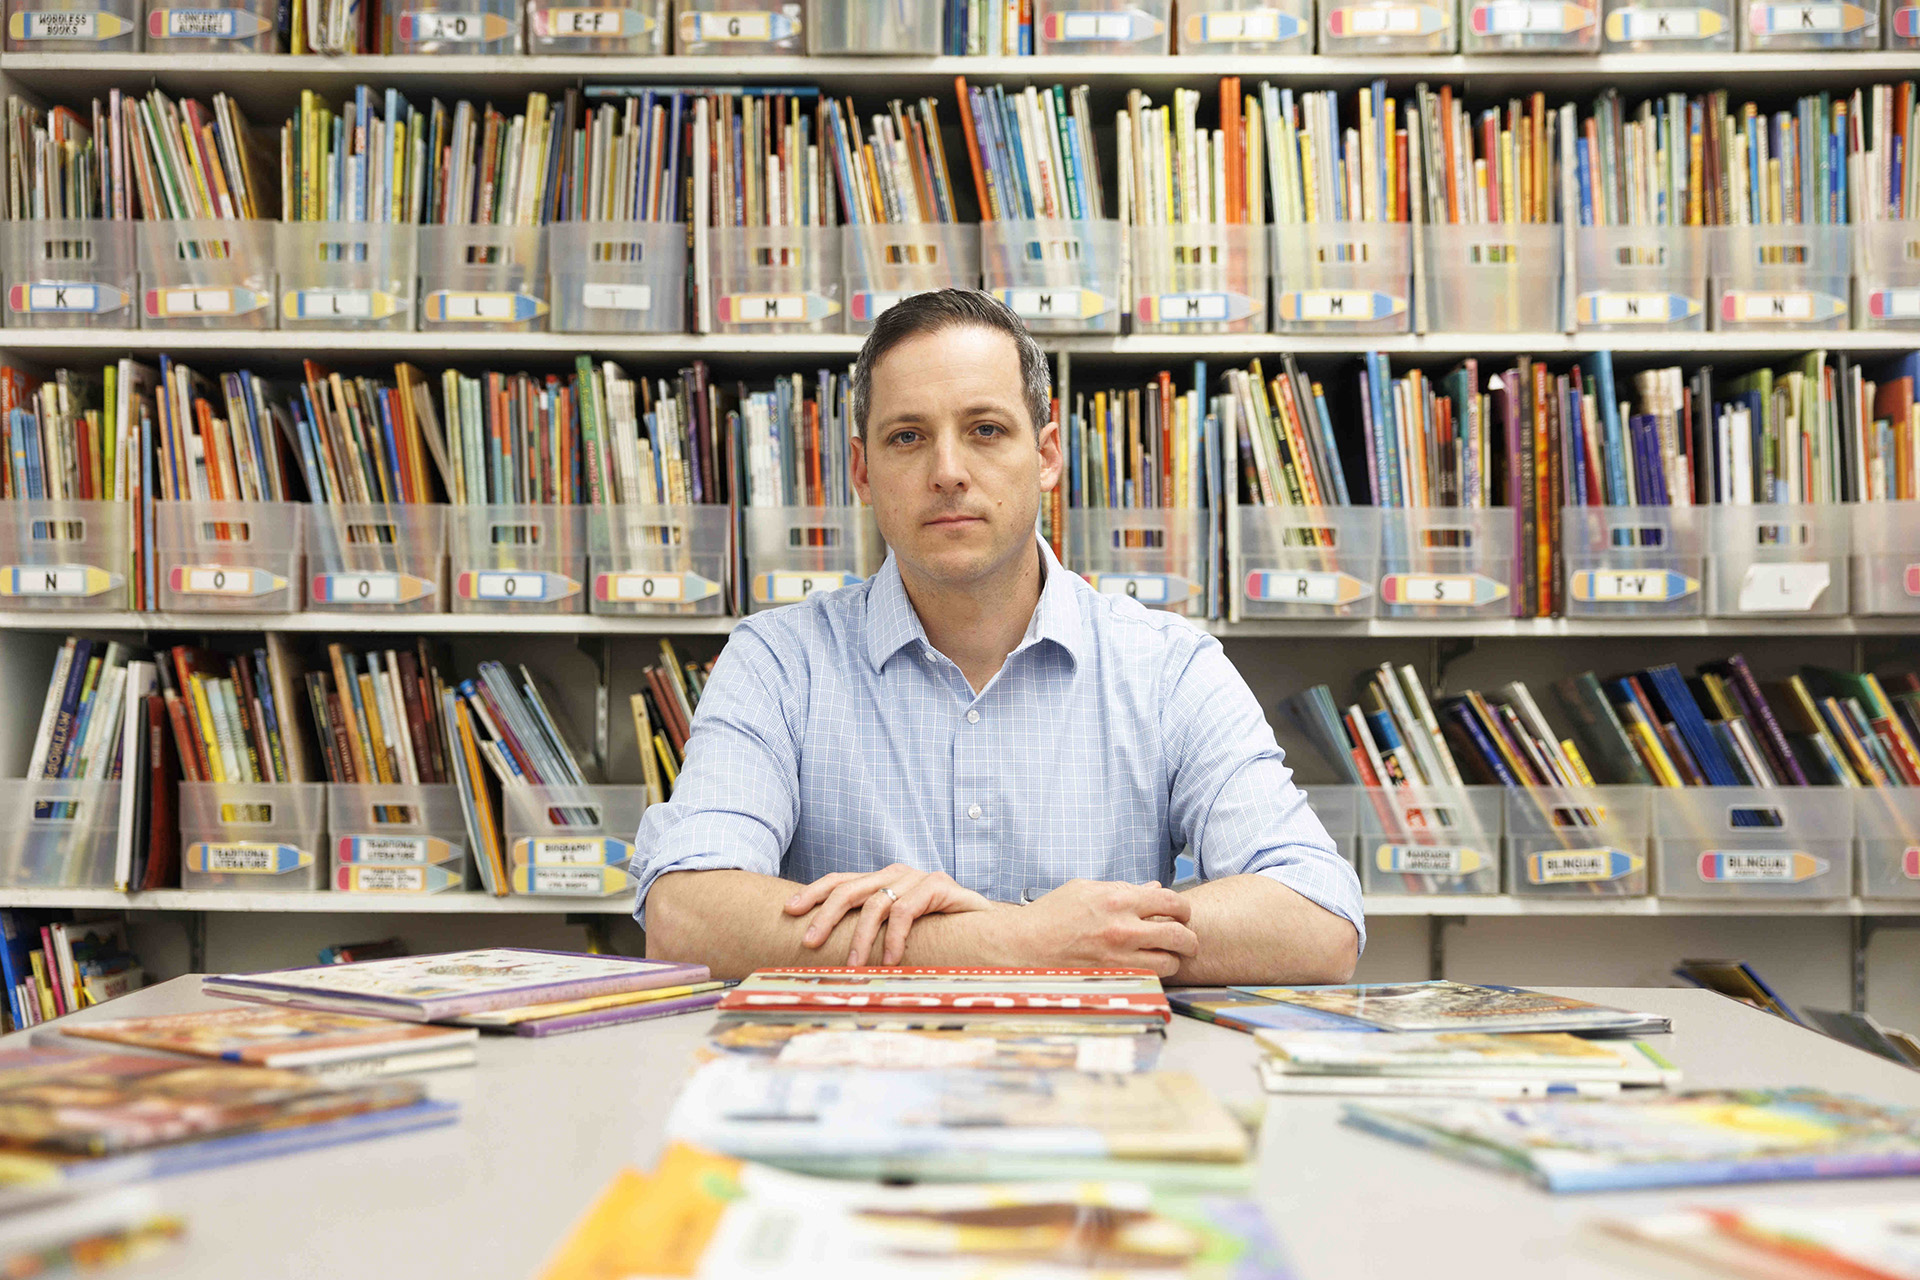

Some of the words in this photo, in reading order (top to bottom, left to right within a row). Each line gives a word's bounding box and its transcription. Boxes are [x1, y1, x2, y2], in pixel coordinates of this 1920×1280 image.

[39, 13, 87, 26] WORDLESS
[433, 17, 467, 37] A-D
[573, 12, 604, 32] E-F
[728, 17, 741, 37] G
[1657, 14, 1670, 31] K
[1801, 9, 1814, 27] K
[46, 25, 78, 36] BOOKS
[55, 289, 68, 308] K
[193, 292, 203, 311] L
[332, 295, 341, 314] L
[605, 290, 621, 306] T
[1039, 294, 1052, 312] M
[1330, 298, 1343, 314] M
[1772, 299, 1784, 315] N
[474, 298, 484, 317] L
[765, 300, 778, 317] M
[1187, 299, 1199, 316] M
[1626, 300, 1638, 315] N
[45, 573, 57, 591] N
[213, 571, 226, 589] O
[358, 580, 371, 598] O
[504, 578, 517, 596] O
[642, 579, 655, 597] O
[802, 579, 813, 597] P
[1296, 579, 1308, 597] R
[1615, 577, 1646, 595] T-V
[1779, 576, 1791, 595] L
[1126, 581, 1137, 599] Q
[1434, 582, 1445, 600] S
[746, 994, 1152, 1009] TRUCKS
